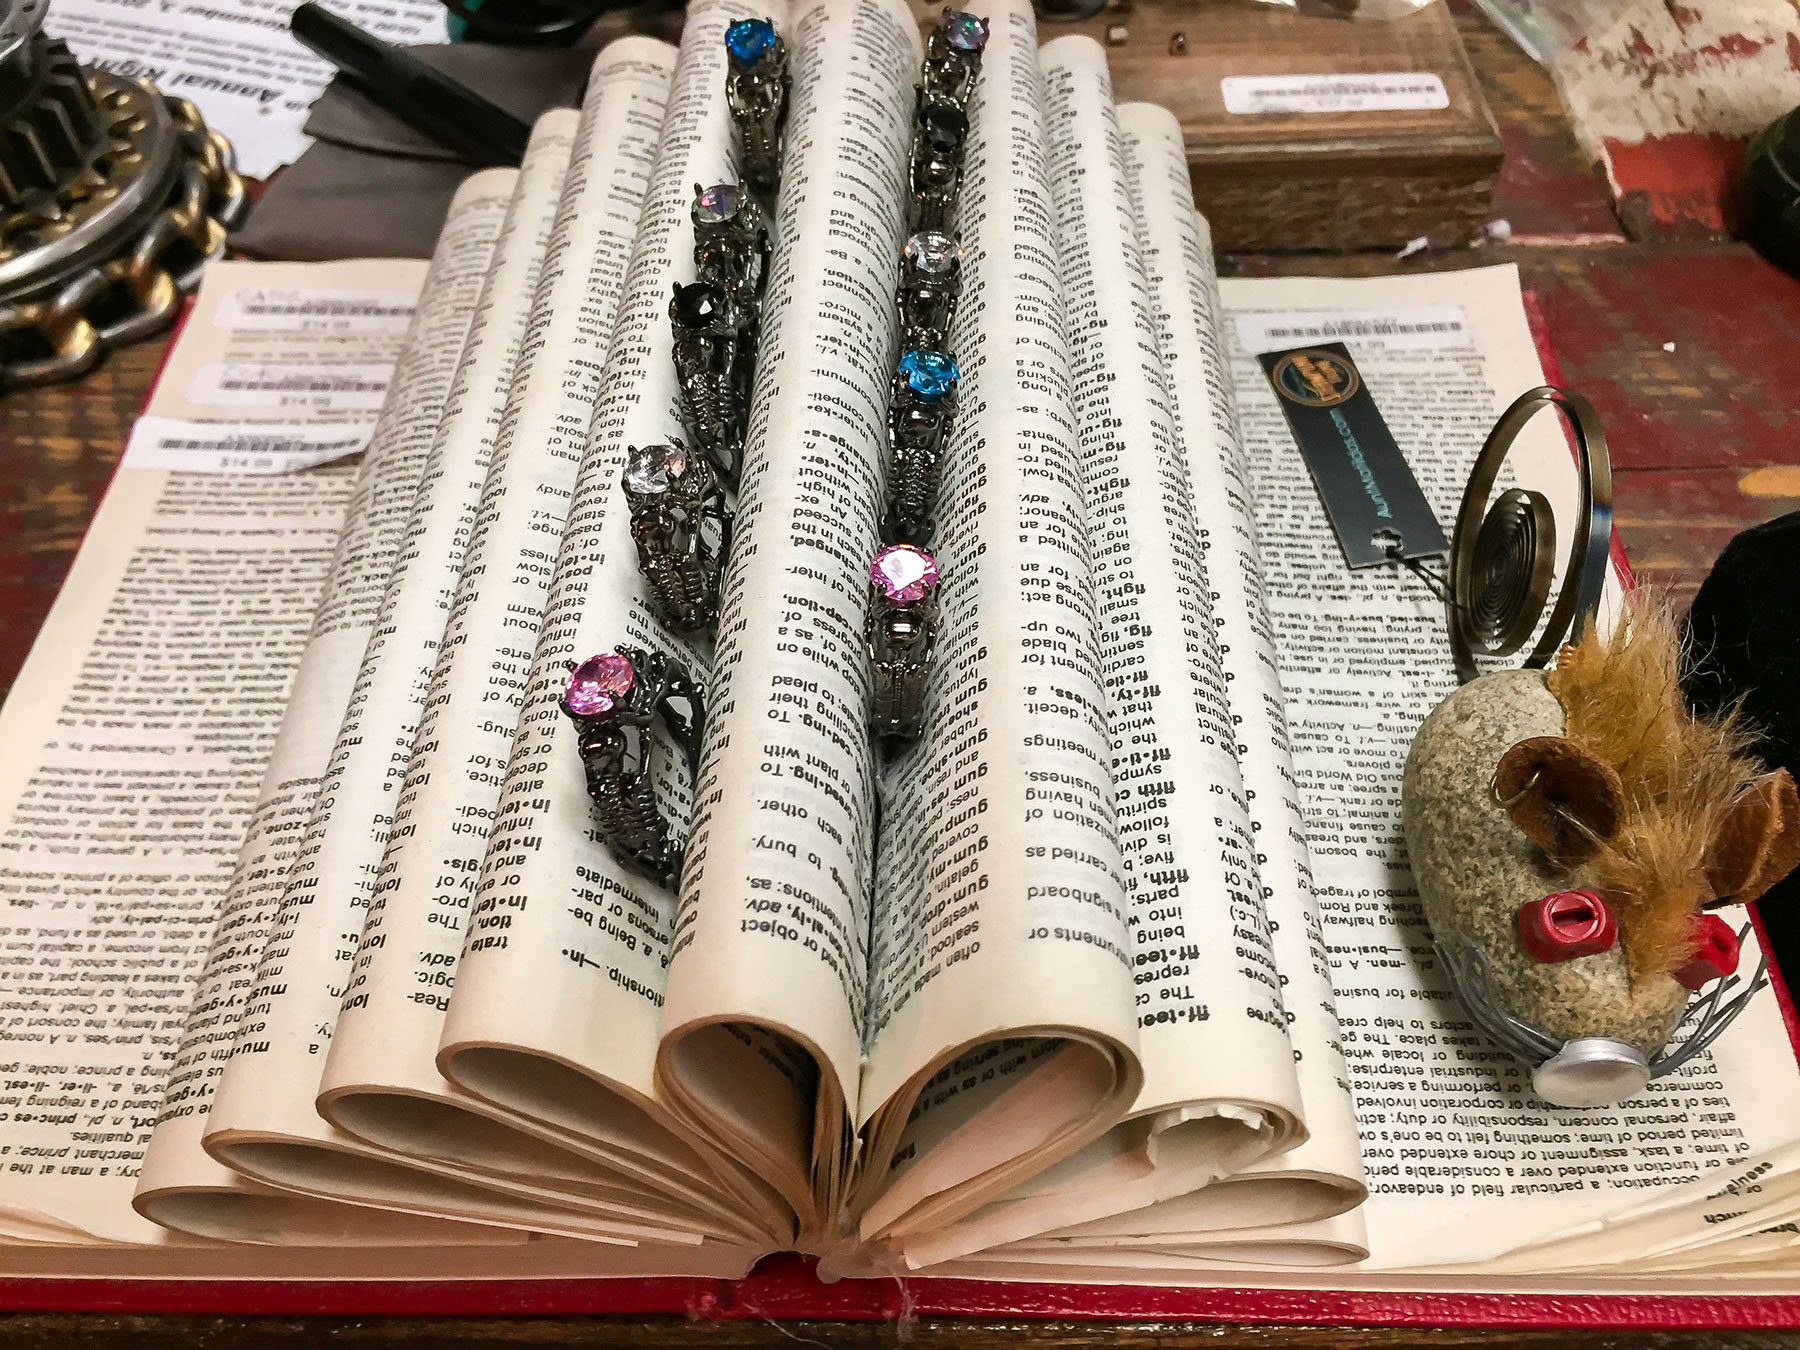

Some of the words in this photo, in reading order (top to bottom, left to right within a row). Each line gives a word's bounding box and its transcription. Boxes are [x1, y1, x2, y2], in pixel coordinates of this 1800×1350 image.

[1019, 494, 1050, 504] adv.
[1021, 563, 1040, 571] an
[1048, 566, 1069, 580] for
[1020, 578, 1050, 588] due
[1021, 592, 1051, 602] act;
[1102, 583, 1146, 600] fight,
[1099, 598, 1138, 615] small
[1111, 612, 1140, 624] tree
[1056, 626, 1081, 644] two
[1124, 624, 1152, 637] fig,
[1022, 639, 1066, 653] blade
[1021, 654, 1045, 665] for
[772, 676, 818, 693] plead
[769, 693, 808, 709] their
[1024, 703, 1078, 719] deceit.
[1122, 701, 1153, 716] that
[768, 710, 790, 723] To
[939, 717, 978, 750] rubber
[1132, 733, 1157, 744] the
[764, 745, 800, 759] with
[1023, 734, 1096, 763] meetings
[1316, 746, 1334, 754] act
[1354, 747, 1385, 756] move
[806, 753, 838, 781] plant
[956, 751, 978, 774] and
[1344, 760, 1390, 770] plovers.
[760, 763, 783, 776] To
[954, 762, 988, 790] gum
[1316, 770, 1351, 782] World
[1355, 771, 1377, 782] Old
[1025, 771, 1100, 799] business,
[1138, 781, 1176, 797] fifth
[1026, 788, 1082, 808] having
[757, 800, 808, 818] other.
[1025, 808, 1043, 822] of
[1350, 823, 1385, 831] cause
[1344, 836, 1367, 844] and
[752, 835, 796, 858] bury.
[1025, 847, 1046, 857] as
[1309, 846, 1357, 859] bosom;
[1139, 851, 1174, 866] five;
[1366, 849, 1386, 858] the
[495, 855, 526, 872] and
[808, 853, 821, 870] to
[1052, 848, 1107, 872] carried
[435, 876, 455, 888] of
[501, 874, 520, 886] or
[746, 876, 772, 890] as,
[1144, 869, 1190, 886] fifth,
[576, 866, 658, 923] intermediate
[1027, 886, 1112, 913] signboard
[1131, 885, 1179, 906] parts;
[608, 903, 622, 916] or
[744, 898, 782, 913] adv.
[1355, 903, 1378, 912] and
[931, 901, 979, 936] western
[1149, 907, 1182, 921] into
[428, 913, 460, 930] The
[1323, 915, 1374, 928] halfway
[599, 916, 636, 951] Being
[740, 920, 798, 940] object
[1028, 927, 1048, 939] or
[1137, 926, 1185, 944] being
[803, 936, 818, 952] or
[946, 942, 980, 967] often
[1160, 986, 1194, 1000] The
[1374, 1016, 1404, 1030] help
[1410, 1020, 1424, 1030] to
[1364, 1034, 1390, 1045] The
[1395, 1034, 1436, 1046] place.
[1382, 1050, 1424, 1062] locale
[126, 1068, 136, 1076] a
[1345, 1063, 1424, 1076] enterprise;
[1430, 1068, 1497, 1078] industrial
[1349, 1079, 1404, 1092] service;
[1409, 1082, 1416, 1090] a
[1421, 1080, 1502, 1094] performing
[26, 1095, 86, 1107] reigning
[90, 1099, 100, 1108] a
[102, 1100, 118, 1110] of
[1356, 1098, 1416, 1109] involved
[1420, 1097, 1504, 1110] corporation
[1618, 1098, 1667, 1109] person
[1673, 1098, 1680, 1107] a
[1684, 1098, 1698, 1109] of
[1702, 1097, 1730, 1108] ties
[1390, 1112, 1427, 1126] duty;
[1432, 1115, 1447, 1124] or
[1452, 1113, 1548, 1127] responsibility
[1554, 1116, 1618, 1126] concern,
[1624, 1112, 1688, 1127] personal
[70, 1132, 134, 1144] qualities.
[1380, 1131, 1420, 1143] one's
[1425, 1132, 1443, 1143] be
[1447, 1132, 1462, 1143] to
[1465, 1132, 1490, 1144] felt
[1494, 1130, 1571, 1145] something
[1574, 1133, 1613, 1144] time;
[1618, 1132, 1632, 1144] of
[1637, 1128, 1686, 1142] period
[1691, 1128, 1744, 1140] limited
[1, 1146, 11, 1154] a
[15, 1145, 71, 1159] prince;
[1362, 1148, 1394, 1158] over
[1633, 1147, 1670, 1158] task,
[1673, 1146, 1684, 1154] a
[1734, 1142, 1750, 1153] of
[74, 1149, 144, 1161] merchant
[1400, 1149, 1468, 1160] extended
[1474, 1150, 1515, 1162] chore
[1521, 1151, 1536, 1160] or
[1541, 1147, 1628, 1161] assignment
[10, 1163, 33, 1174] the
[39, 1165, 55, 1175] at
[1634, 1161, 1699, 1173] function
[1705, 1160, 1720, 1168] or
[61, 1166, 94, 1175] man
[99, 1167, 109, 1176] a
[1405, 1166, 1500, 1178] considerable
[1504, 1168, 1514, 1177] a
[1520, 1168, 1552, 1176] over
[1558, 1164, 1628, 1178] extended
[1369, 1182, 1444, 1195] endeavor;
[1451, 1184, 1464, 1197] of
[1472, 1184, 1504, 1197] field
[1510, 1180, 1584, 1195] particular
[1590, 1181, 1600, 1189] a
